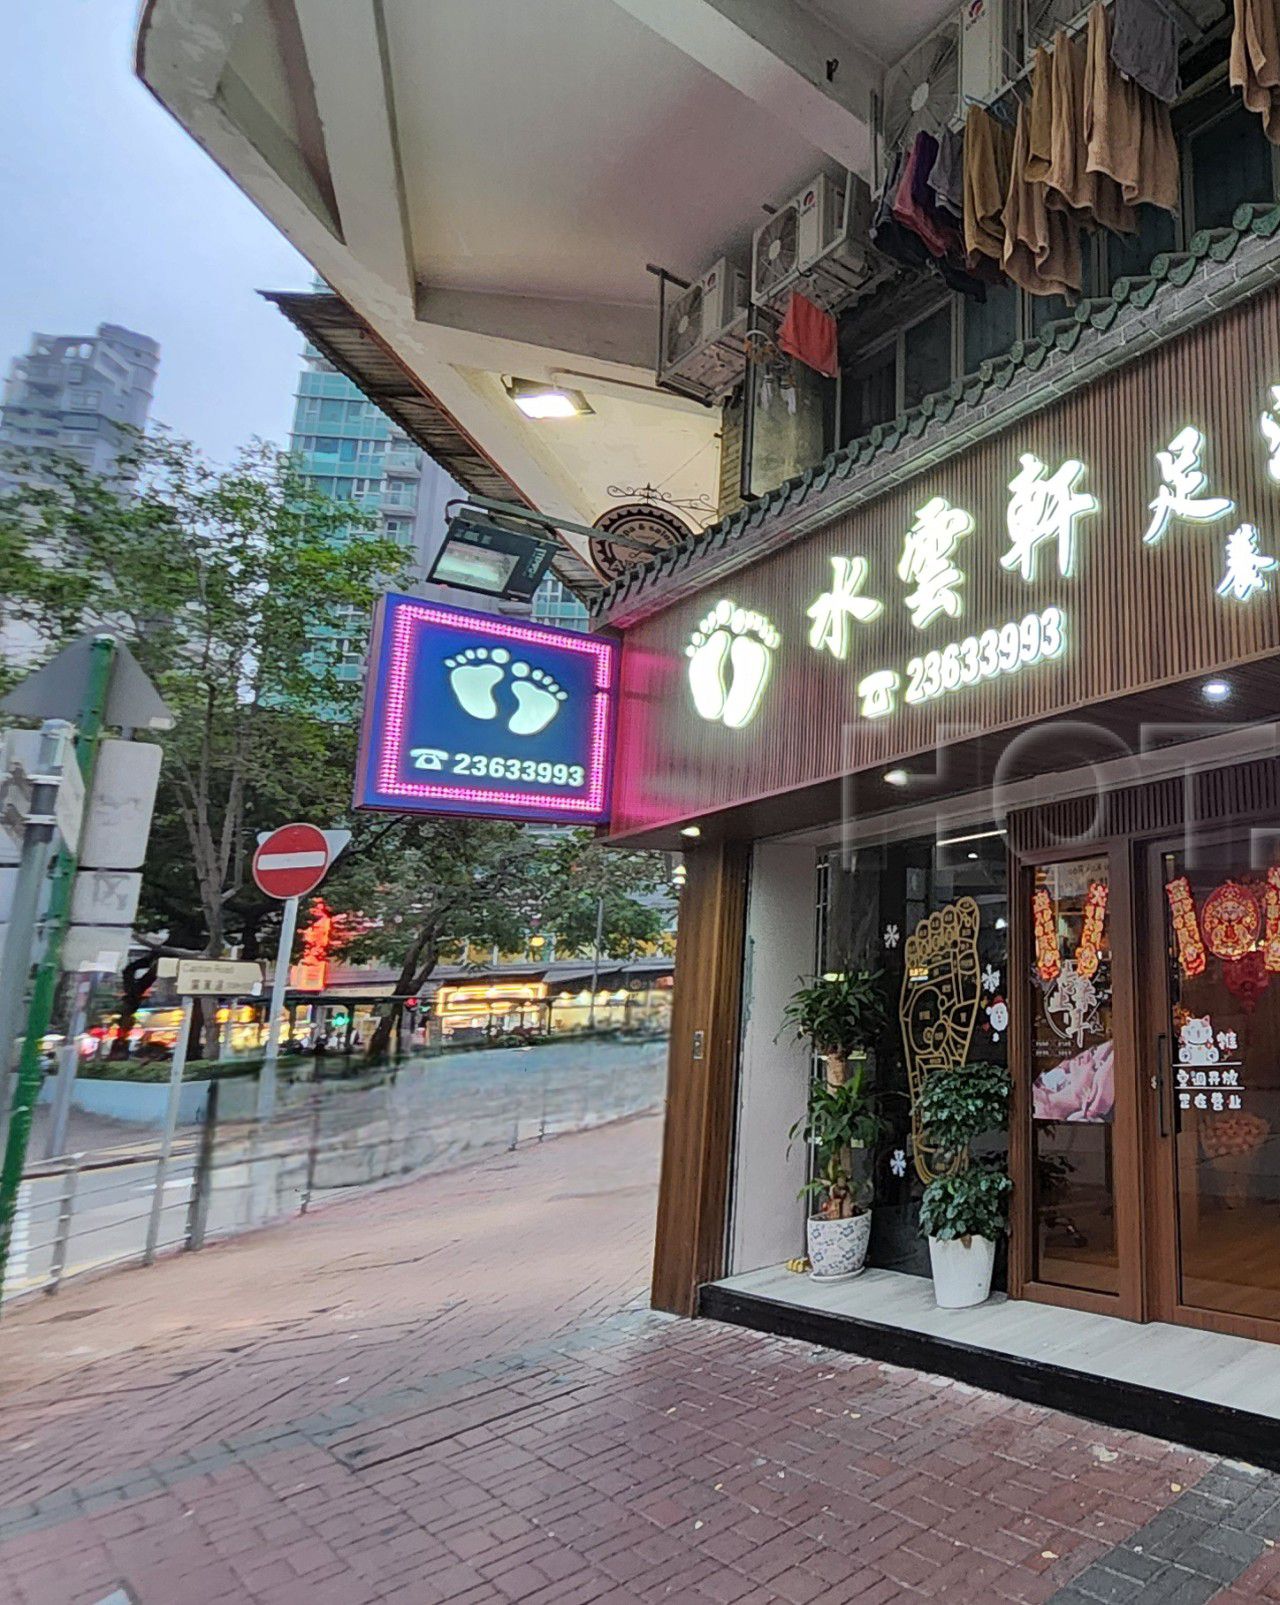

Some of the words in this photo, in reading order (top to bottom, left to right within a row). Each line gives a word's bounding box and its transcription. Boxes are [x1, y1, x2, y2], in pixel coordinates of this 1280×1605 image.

[805, 453, 1100, 660] 水雲軒
[905, 605, 1067, 705] 23633993
[453, 752, 586, 787] 23633993
